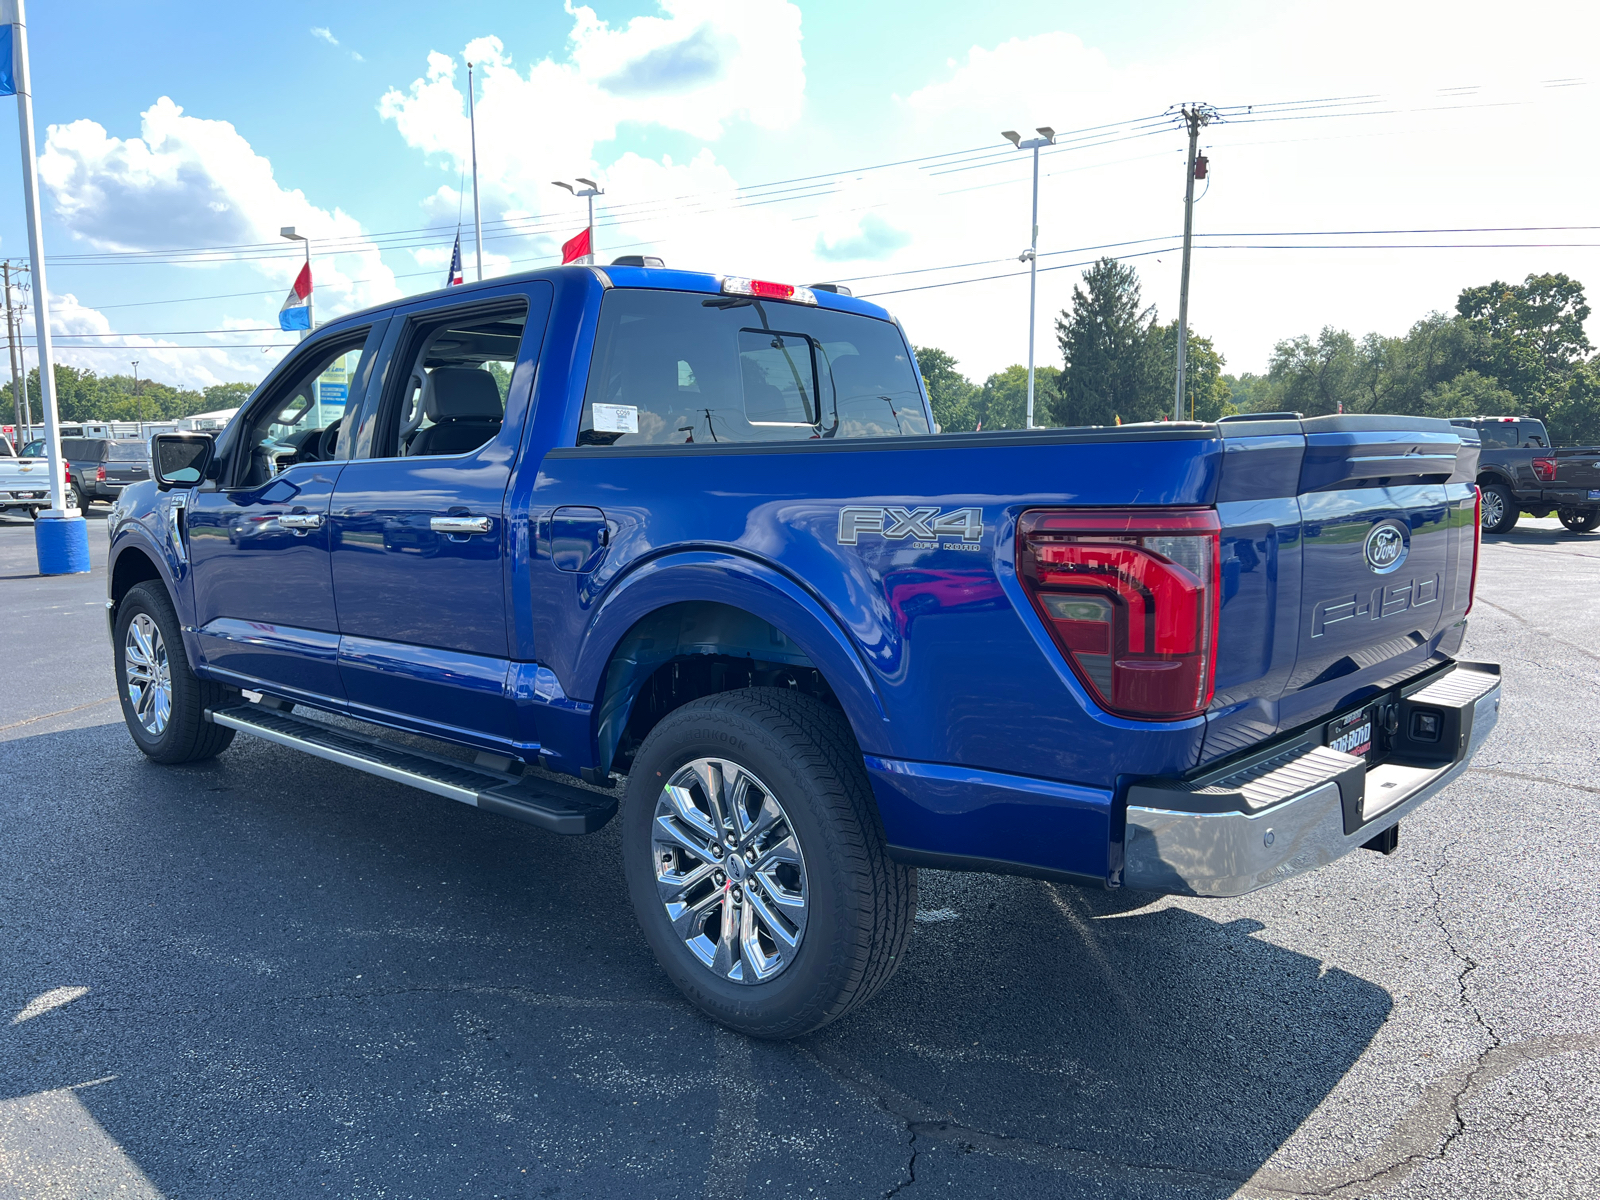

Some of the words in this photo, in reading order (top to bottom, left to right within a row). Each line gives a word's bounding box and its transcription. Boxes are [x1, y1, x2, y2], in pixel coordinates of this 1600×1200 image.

[837, 505, 984, 546] FX4
[913, 541, 940, 550] OFF
[943, 542, 981, 552] ROAD
[1374, 532, 1398, 561] Ford
[1311, 572, 1440, 639] F-150
